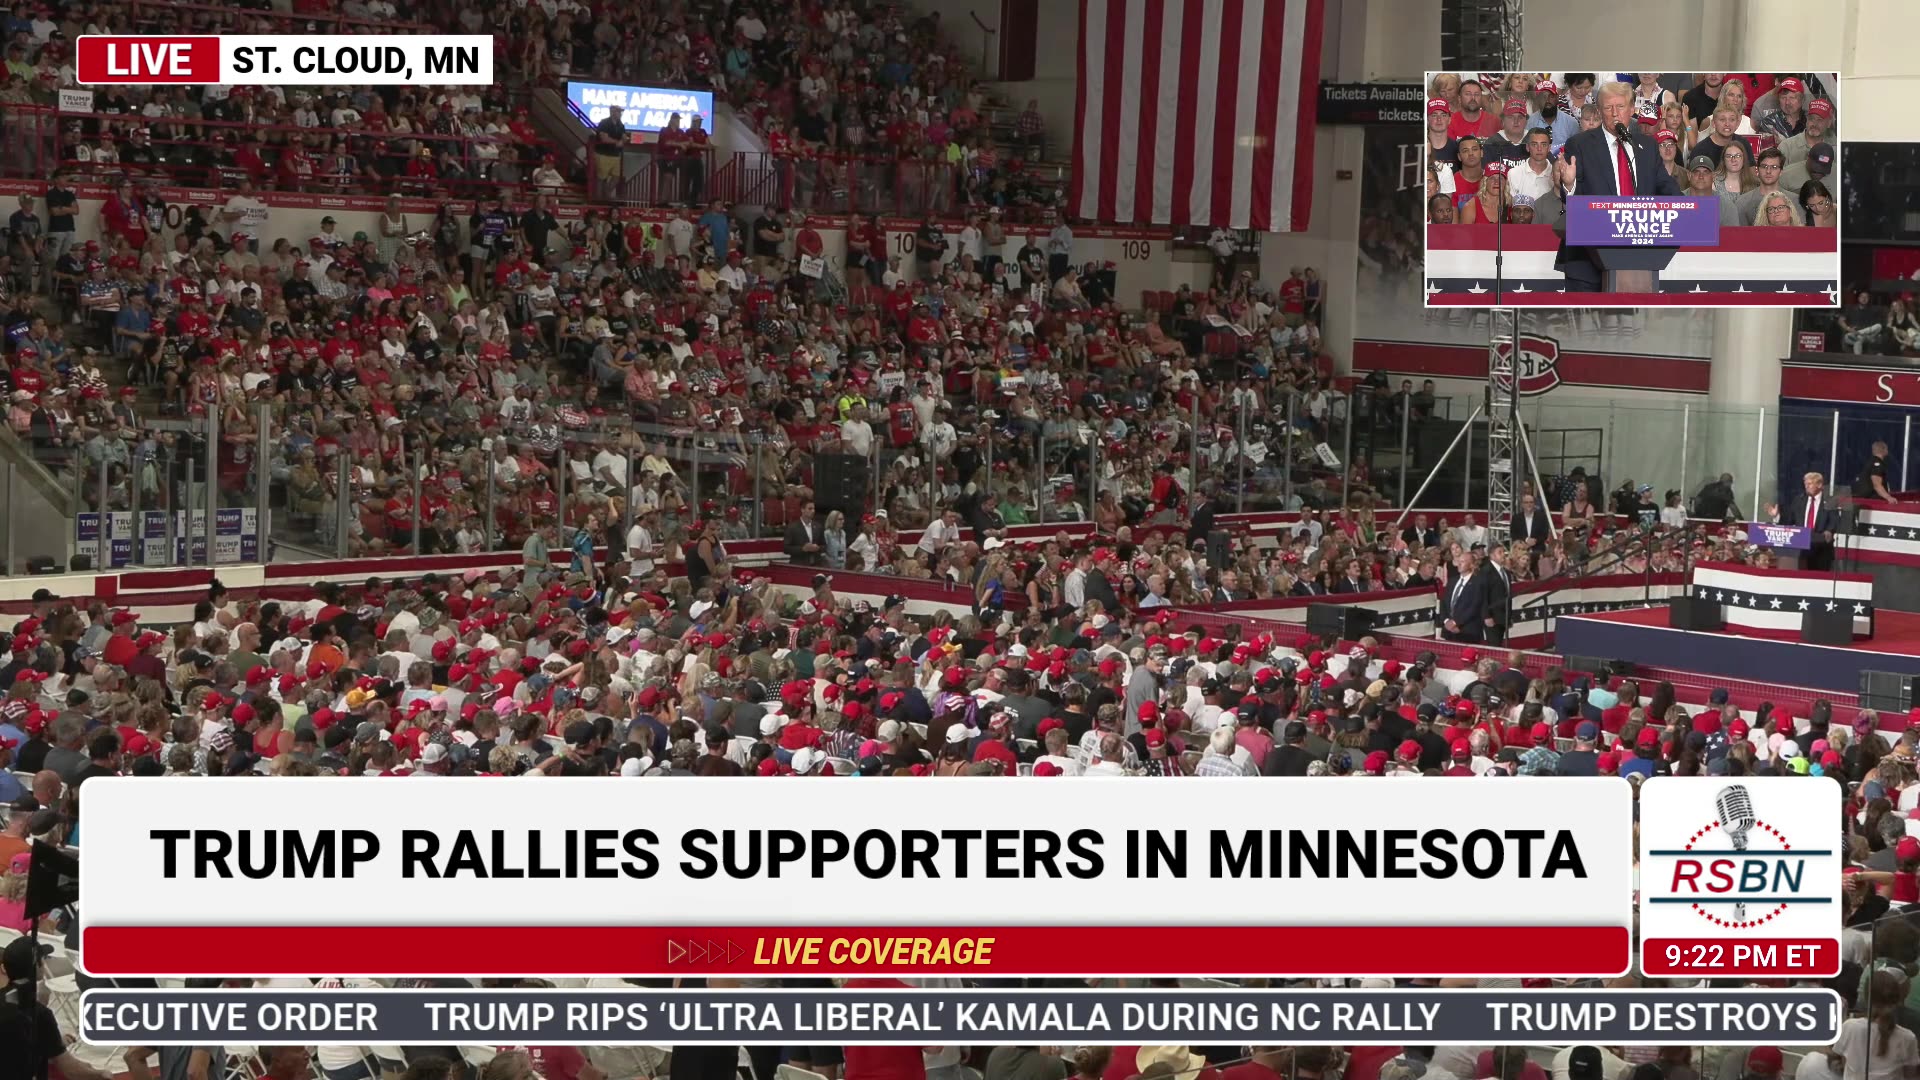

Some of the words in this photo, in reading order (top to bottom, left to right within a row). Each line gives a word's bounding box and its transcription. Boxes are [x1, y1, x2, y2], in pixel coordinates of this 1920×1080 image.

[582, 88, 627, 107] MAKE
[630, 92, 699, 113] AMERICA
[1325, 87, 1368, 100] Tickets
[1370, 87, 1424, 101] Available
[589, 106, 641, 126] GRAT
[643, 111, 692, 129] AGAN
[1378, 108, 1425, 121] tickets.
[1608, 210, 1679, 223] TRUMP
[1616, 222, 1671, 234] VANCE
[894, 233, 915, 254] 10
[1122, 240, 1151, 260] 109
[11, 326, 29, 336] TRU
